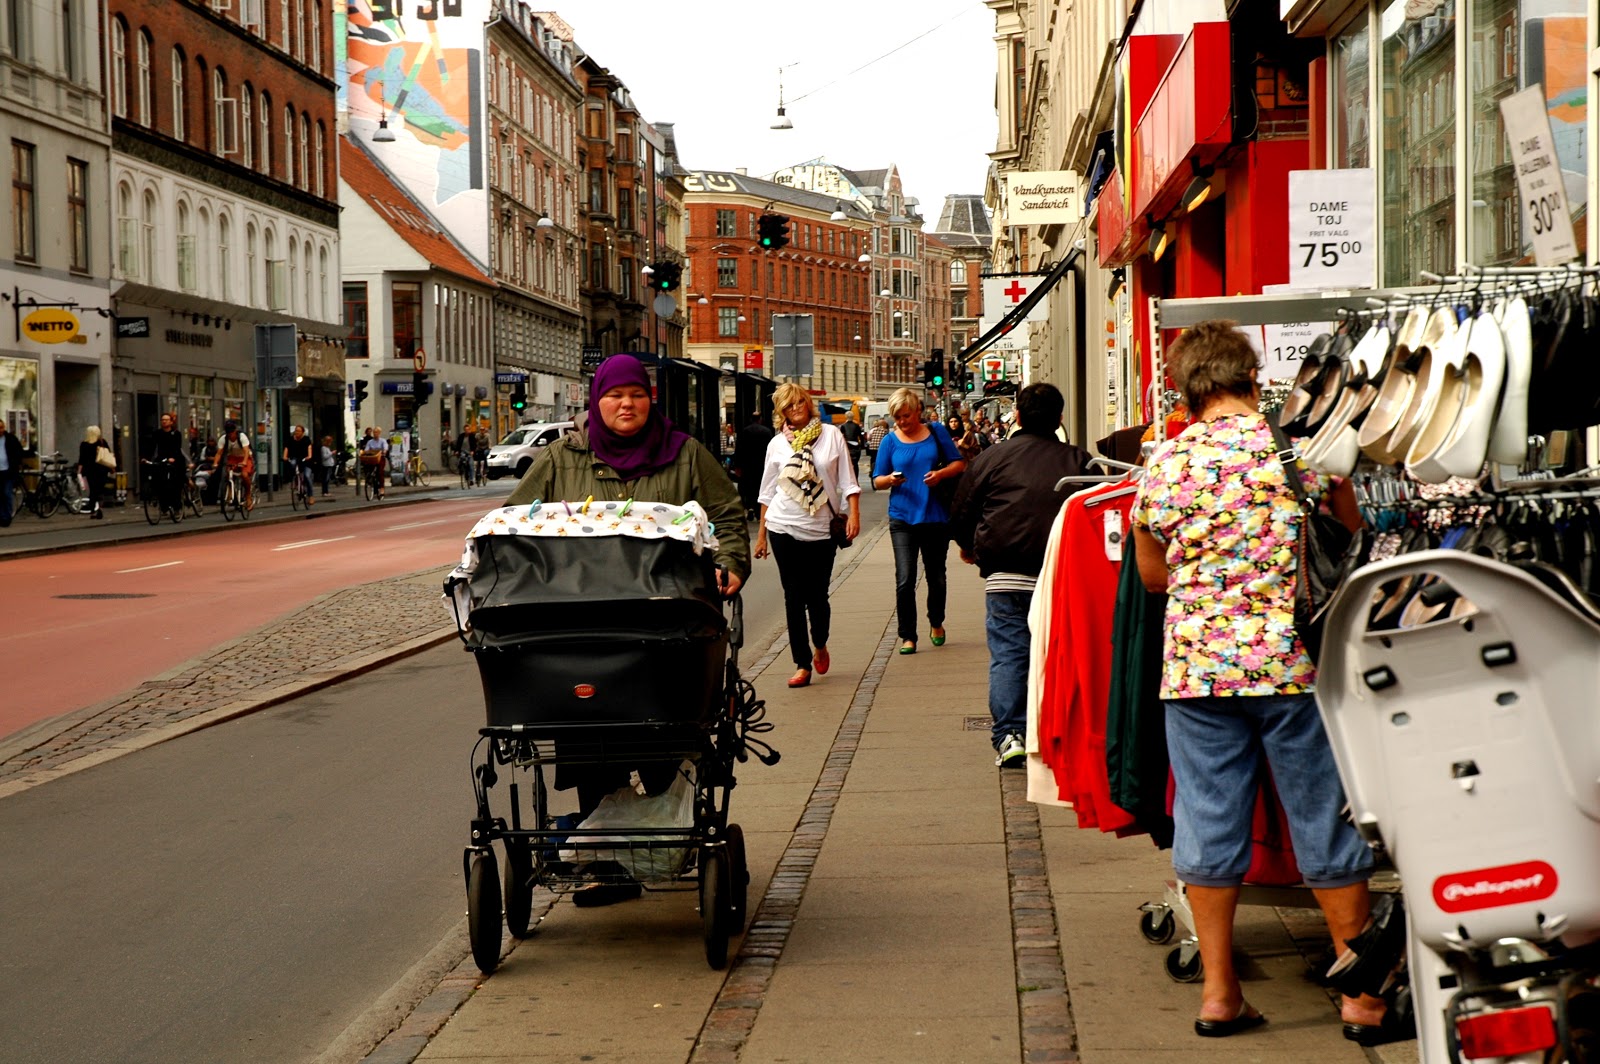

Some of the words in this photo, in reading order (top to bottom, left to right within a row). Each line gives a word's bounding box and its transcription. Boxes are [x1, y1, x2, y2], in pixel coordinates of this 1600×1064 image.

[1013, 184, 1075, 197] Vandkunsten
[1020, 198, 1069, 211] Sandwich
[1310, 201, 1348, 212] DAME
[1317, 215, 1342, 225] TØJ
[1328, 229, 1349, 237] VALG
[33, 321, 74, 331] NETTO
[1274, 345, 1309, 361] 129
